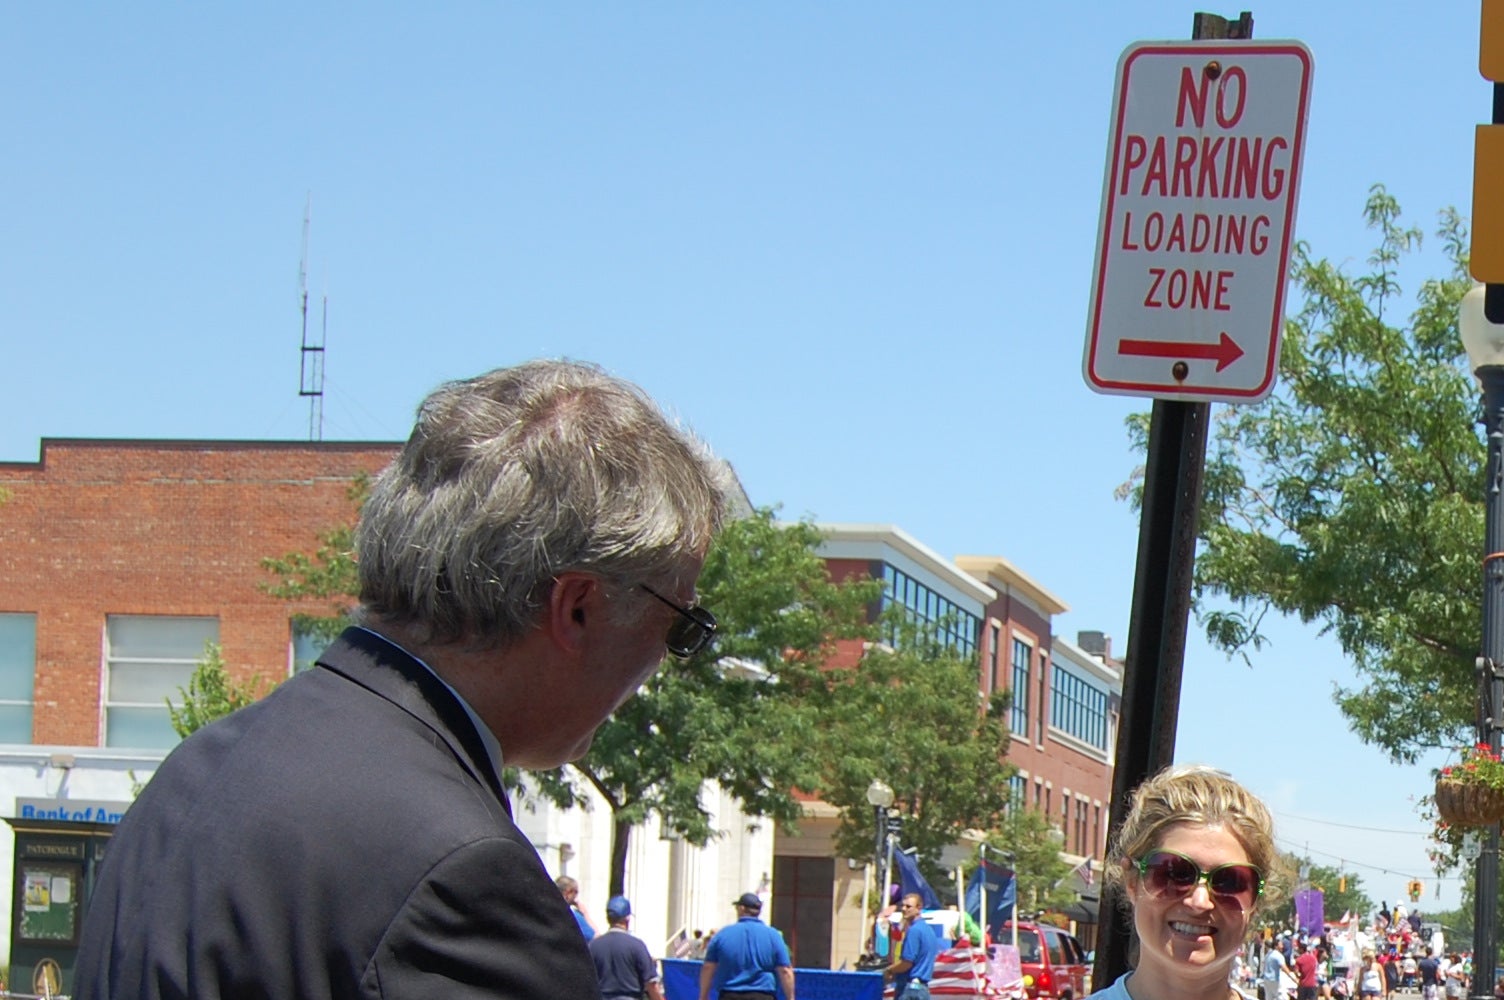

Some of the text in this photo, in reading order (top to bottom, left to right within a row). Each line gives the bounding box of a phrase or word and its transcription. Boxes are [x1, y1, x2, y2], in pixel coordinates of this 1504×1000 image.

[1175, 66, 1247, 129] NO
[1120, 135, 1287, 200] PARKING
[1121, 211, 1270, 256] LOADING
[1144, 268, 1234, 311] ZONE
[22, 805, 69, 820] Bank
[73, 807, 92, 822] of
